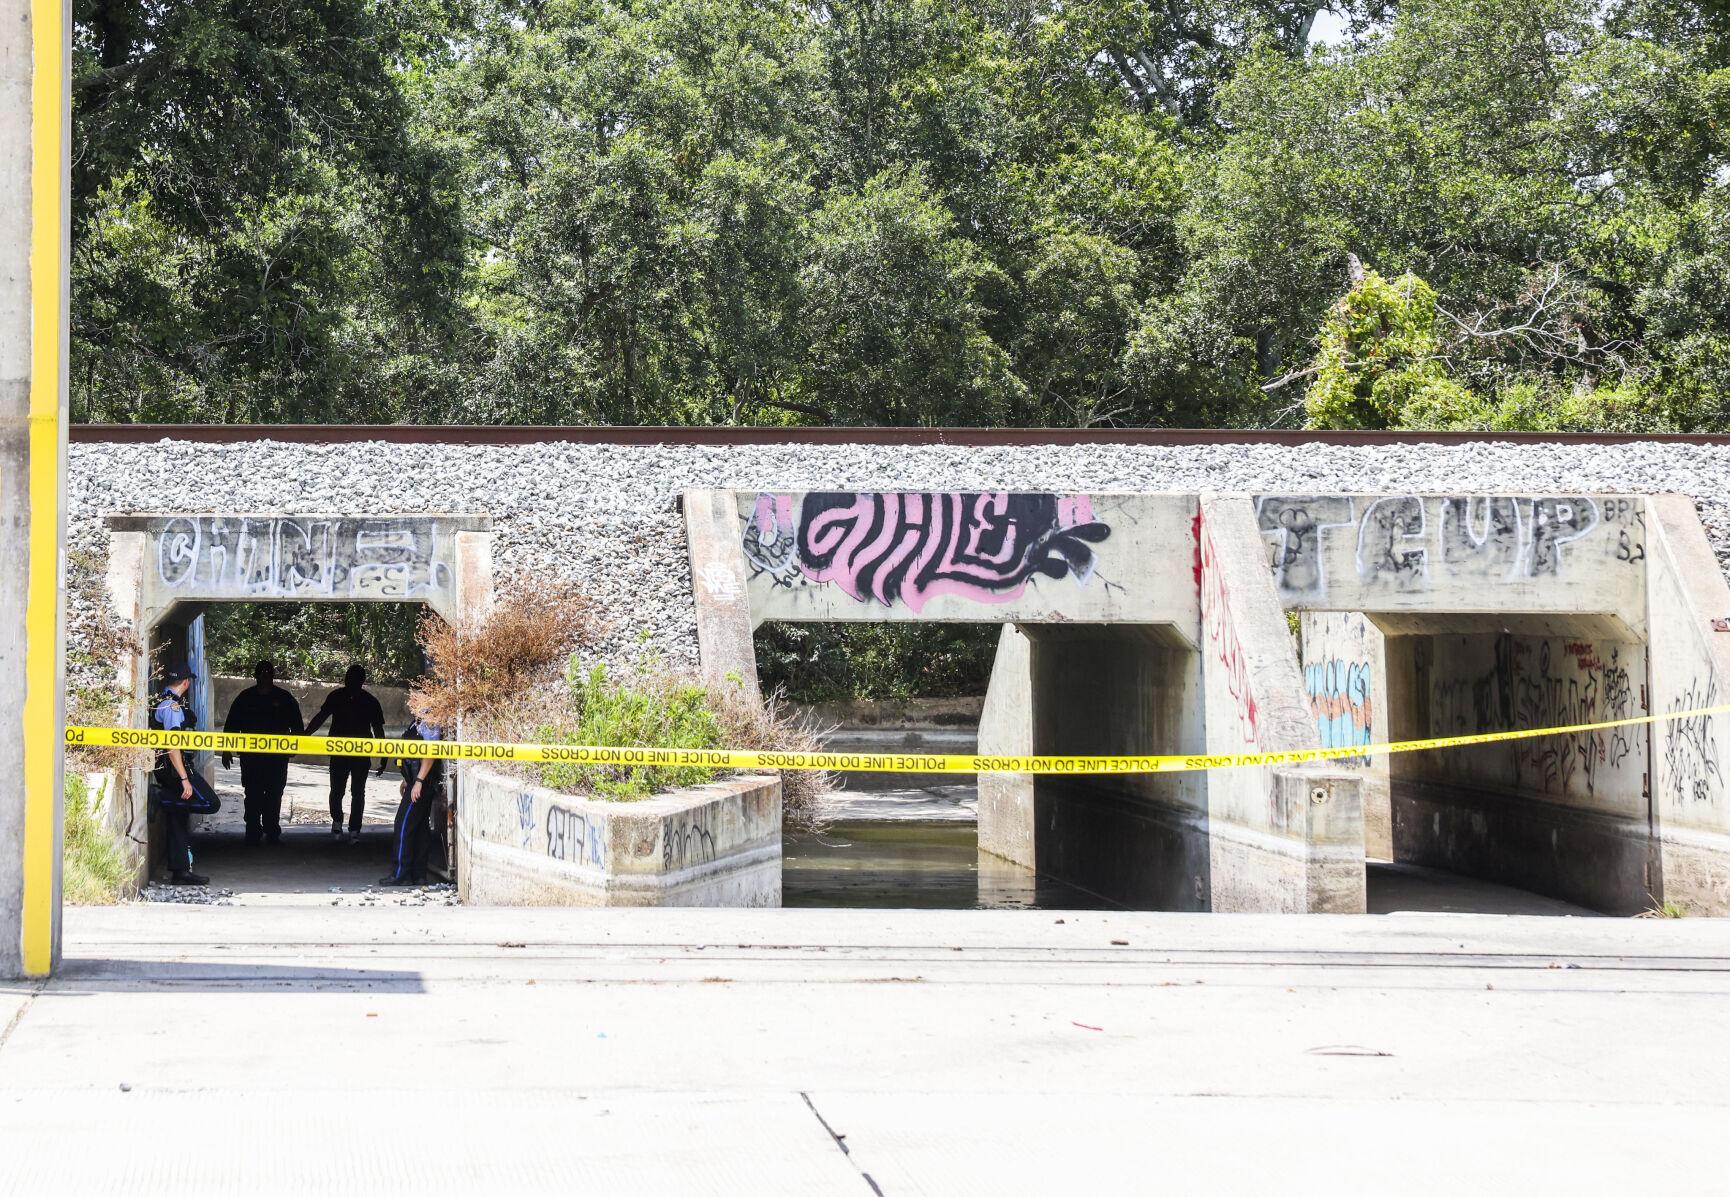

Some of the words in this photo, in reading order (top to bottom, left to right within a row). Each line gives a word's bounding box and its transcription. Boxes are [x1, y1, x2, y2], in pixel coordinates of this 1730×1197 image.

[111, 731, 159, 745] CROSS
[161, 733, 190, 746] NOT
[193, 734, 213, 748] DO
[217, 736, 246, 749] LINE
[249, 738, 299, 751] POLICE
[326, 740, 373, 753] CROSS
[378, 741, 405, 755] NOT
[408, 743, 428, 755] DO
[432, 744, 461, 756] LINE
[465, 745, 514, 757] POLICE
[541, 748, 589, 761] CROSS
[594, 749, 621, 761] NOT
[624, 750, 644, 762] DO
[648, 751, 677, 762] LINE
[681, 752, 730, 764] POLICE
[757, 753, 805, 767] CROSS
[808, 755, 836, 767] NOT
[840, 755, 860, 768] DO
[863, 756, 893, 769] LINE
[896, 757, 946, 770] POLICE
[973, 758, 1020, 771] CROSS
[1024, 759, 1051, 771] NOT
[1054, 759, 1074, 771] DO
[1078, 759, 1107, 771] LINE
[1111, 759, 1159, 771] POLICE
